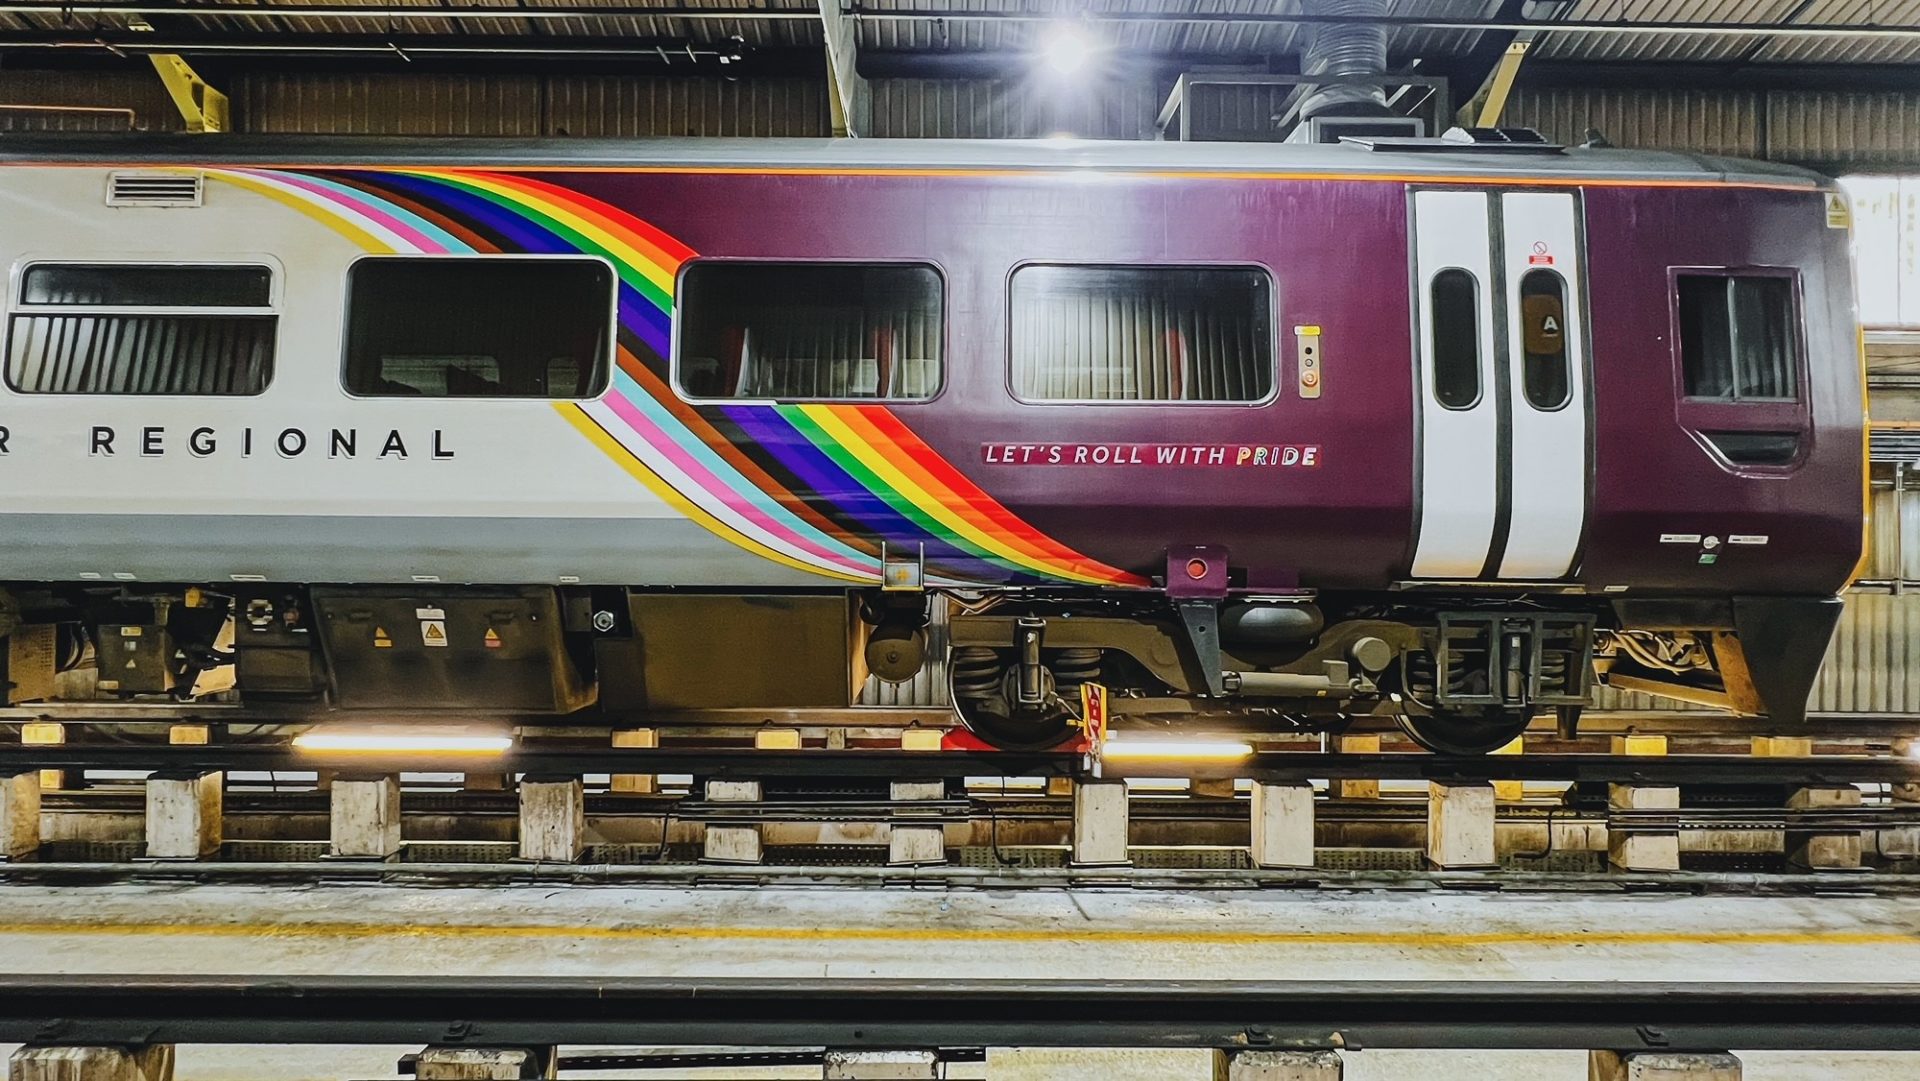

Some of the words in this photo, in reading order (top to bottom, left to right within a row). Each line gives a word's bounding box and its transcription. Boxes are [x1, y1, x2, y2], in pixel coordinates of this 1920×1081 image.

[1543, 315, 1559, 330] A
[89, 425, 455, 459] REGIONAL
[985, 445, 1062, 464] LET'S
[1073, 446, 1142, 464] ROLL
[1156, 447, 1226, 465] WITH
[1236, 446, 1318, 466] PRIDE
